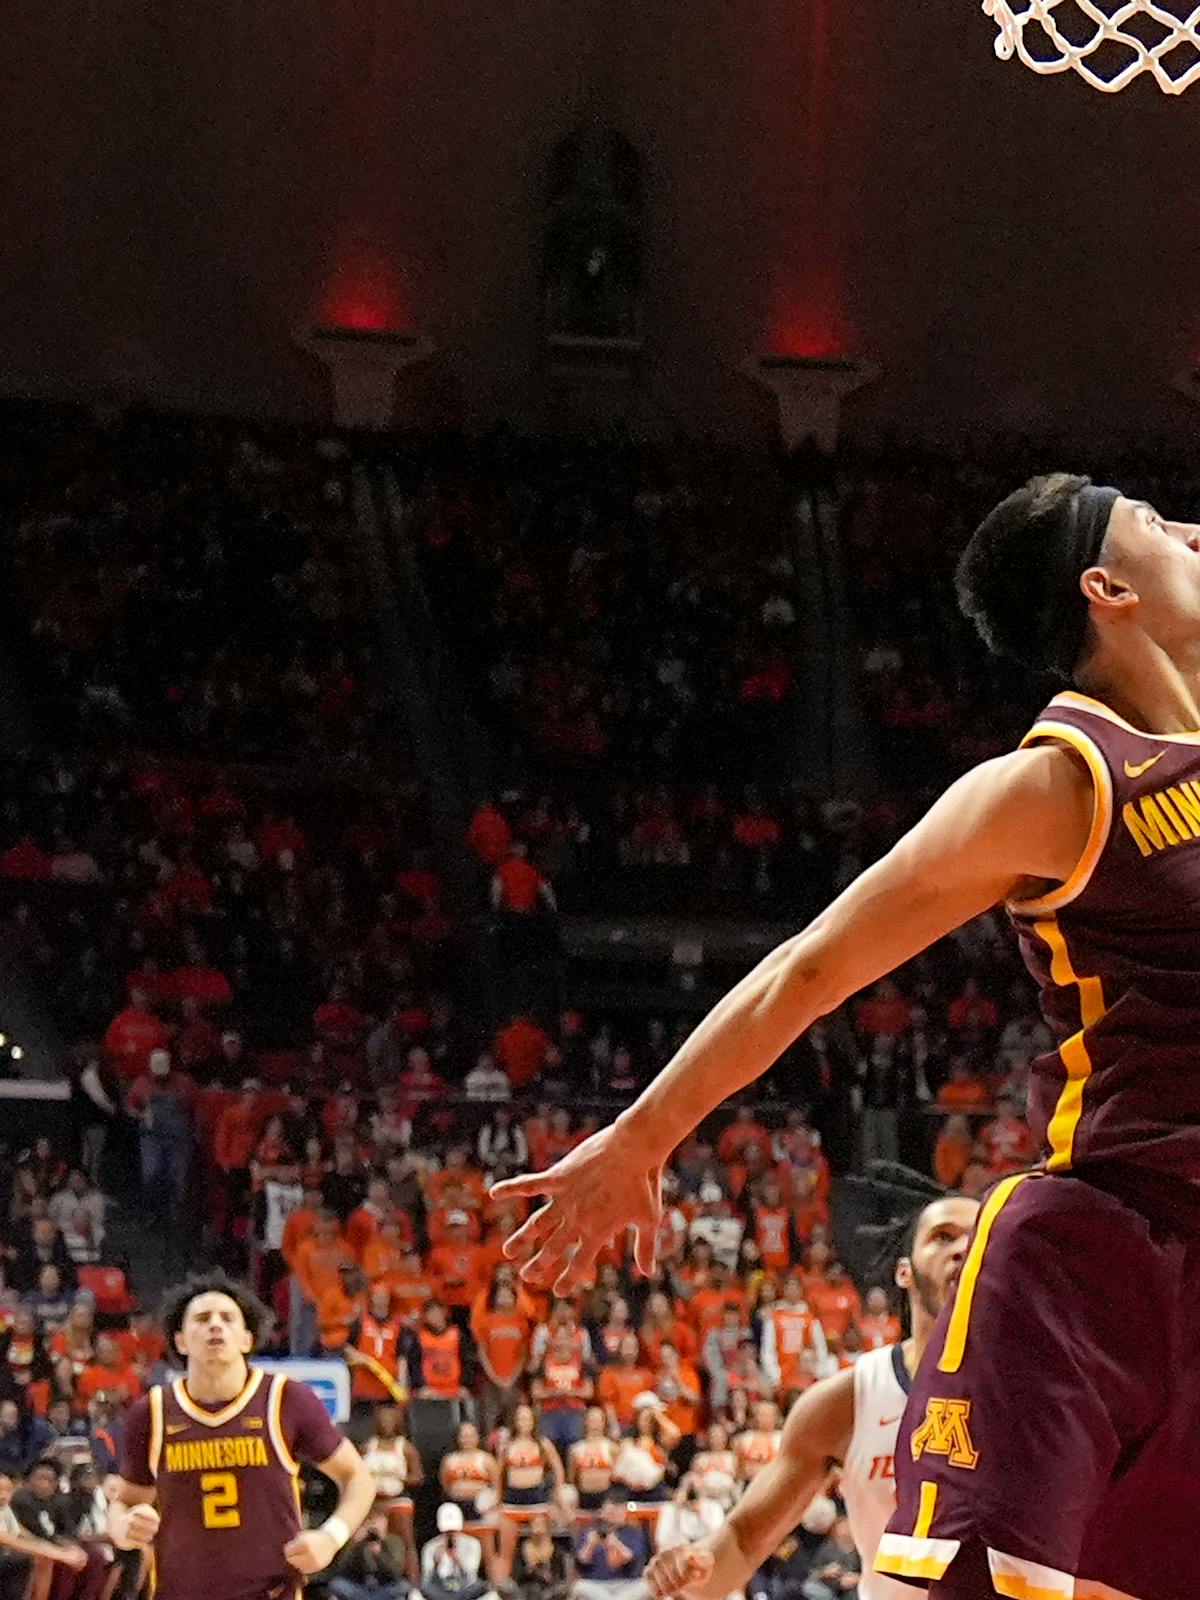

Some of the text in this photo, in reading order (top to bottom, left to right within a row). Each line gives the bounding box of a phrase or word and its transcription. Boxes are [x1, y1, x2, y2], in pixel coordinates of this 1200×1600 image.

[164, 1435, 269, 1473] MINNESOTA
[910, 1396, 980, 1471] M
[201, 1471, 241, 1530] 2
